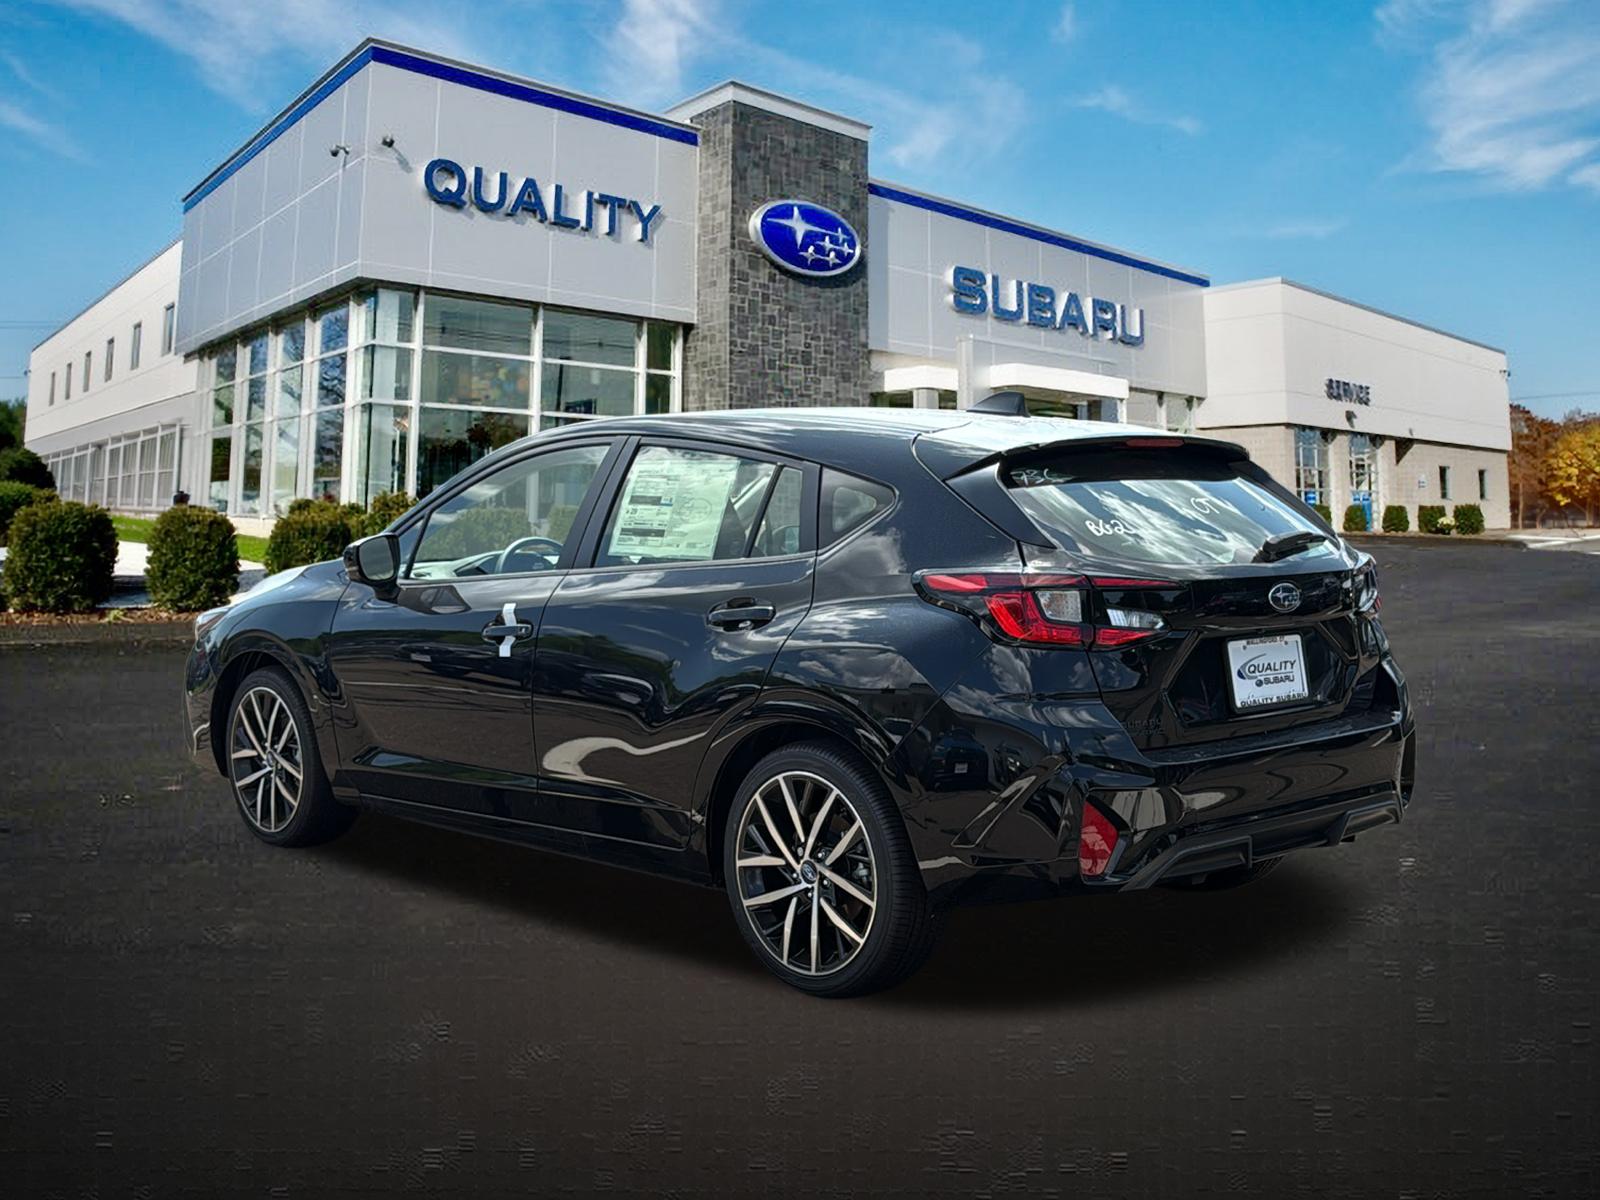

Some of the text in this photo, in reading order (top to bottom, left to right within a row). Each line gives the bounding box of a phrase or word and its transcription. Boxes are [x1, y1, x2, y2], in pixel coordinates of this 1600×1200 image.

[423, 157, 662, 243] QUALITY
[951, 264, 1145, 347] SUBARU
[1325, 378, 1371, 406] SERVICE
[1247, 659, 1296, 674] QUALITY
[1263, 674, 1295, 685] SUBARU
[1240, 692, 1307, 706] QUALITY SUBARU
